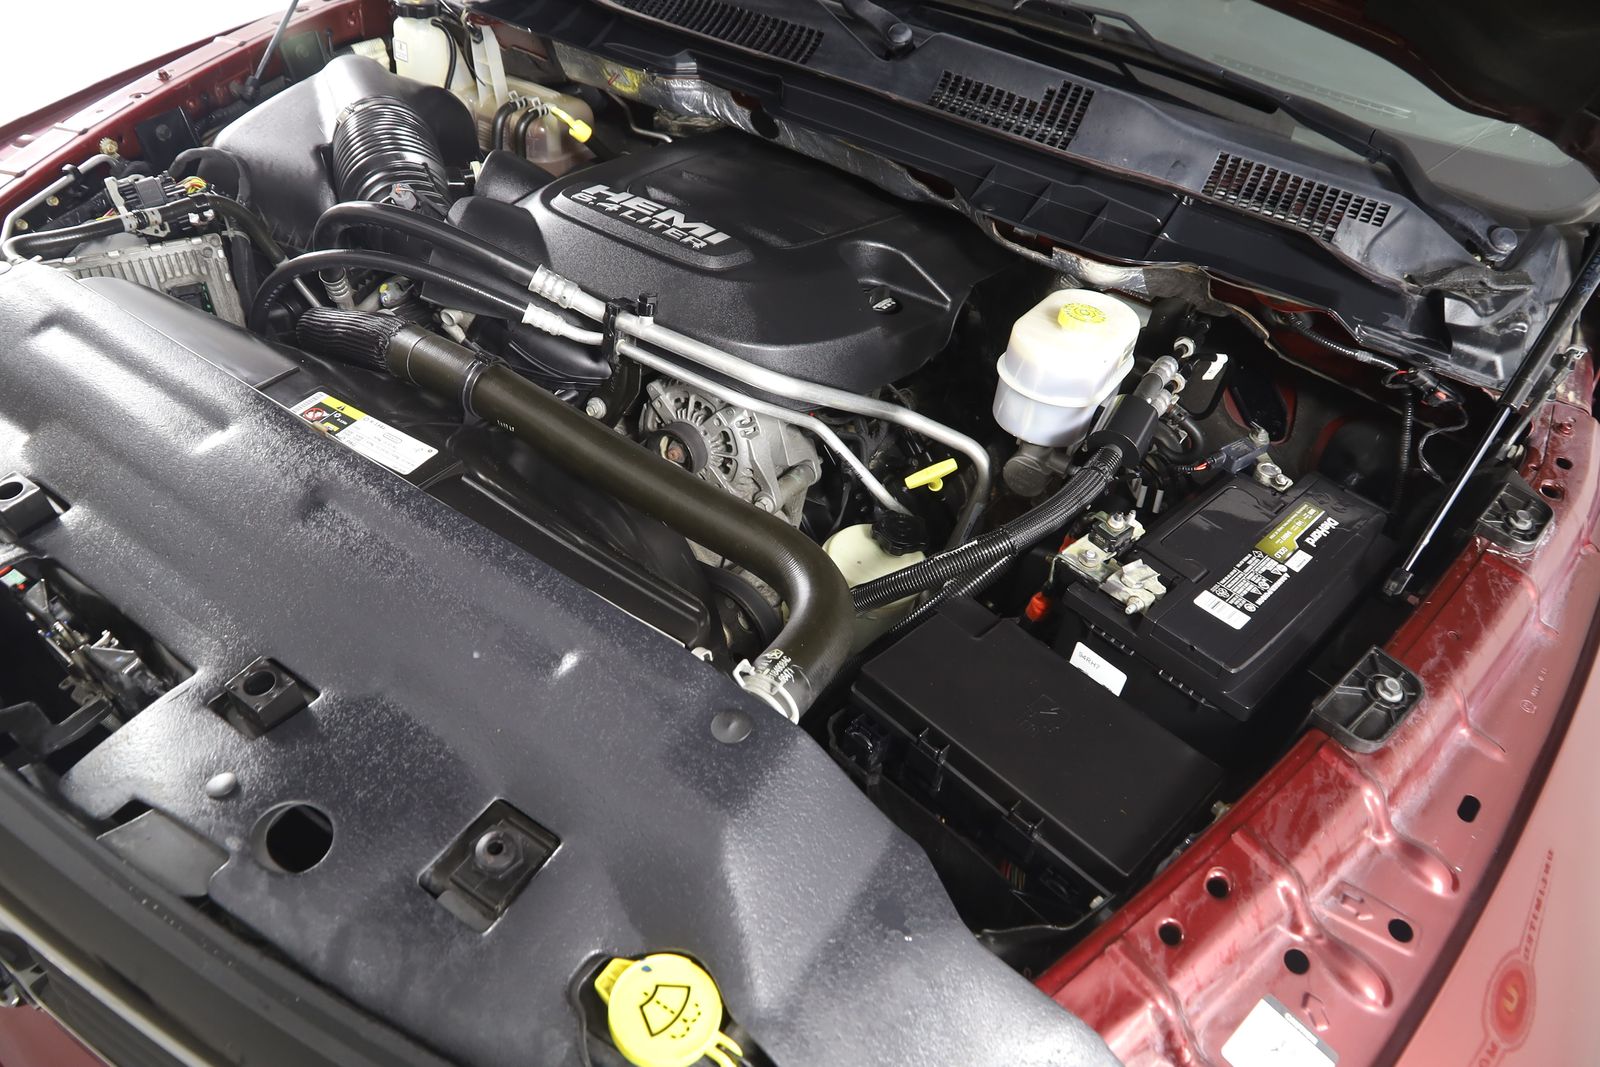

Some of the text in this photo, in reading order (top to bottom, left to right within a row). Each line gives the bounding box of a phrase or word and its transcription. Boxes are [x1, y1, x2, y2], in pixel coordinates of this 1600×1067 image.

[571, 192, 707, 250] 6.4 LITER
[582, 184, 731, 245] HEMI
[1305, 518, 1339, 547] DieHard
